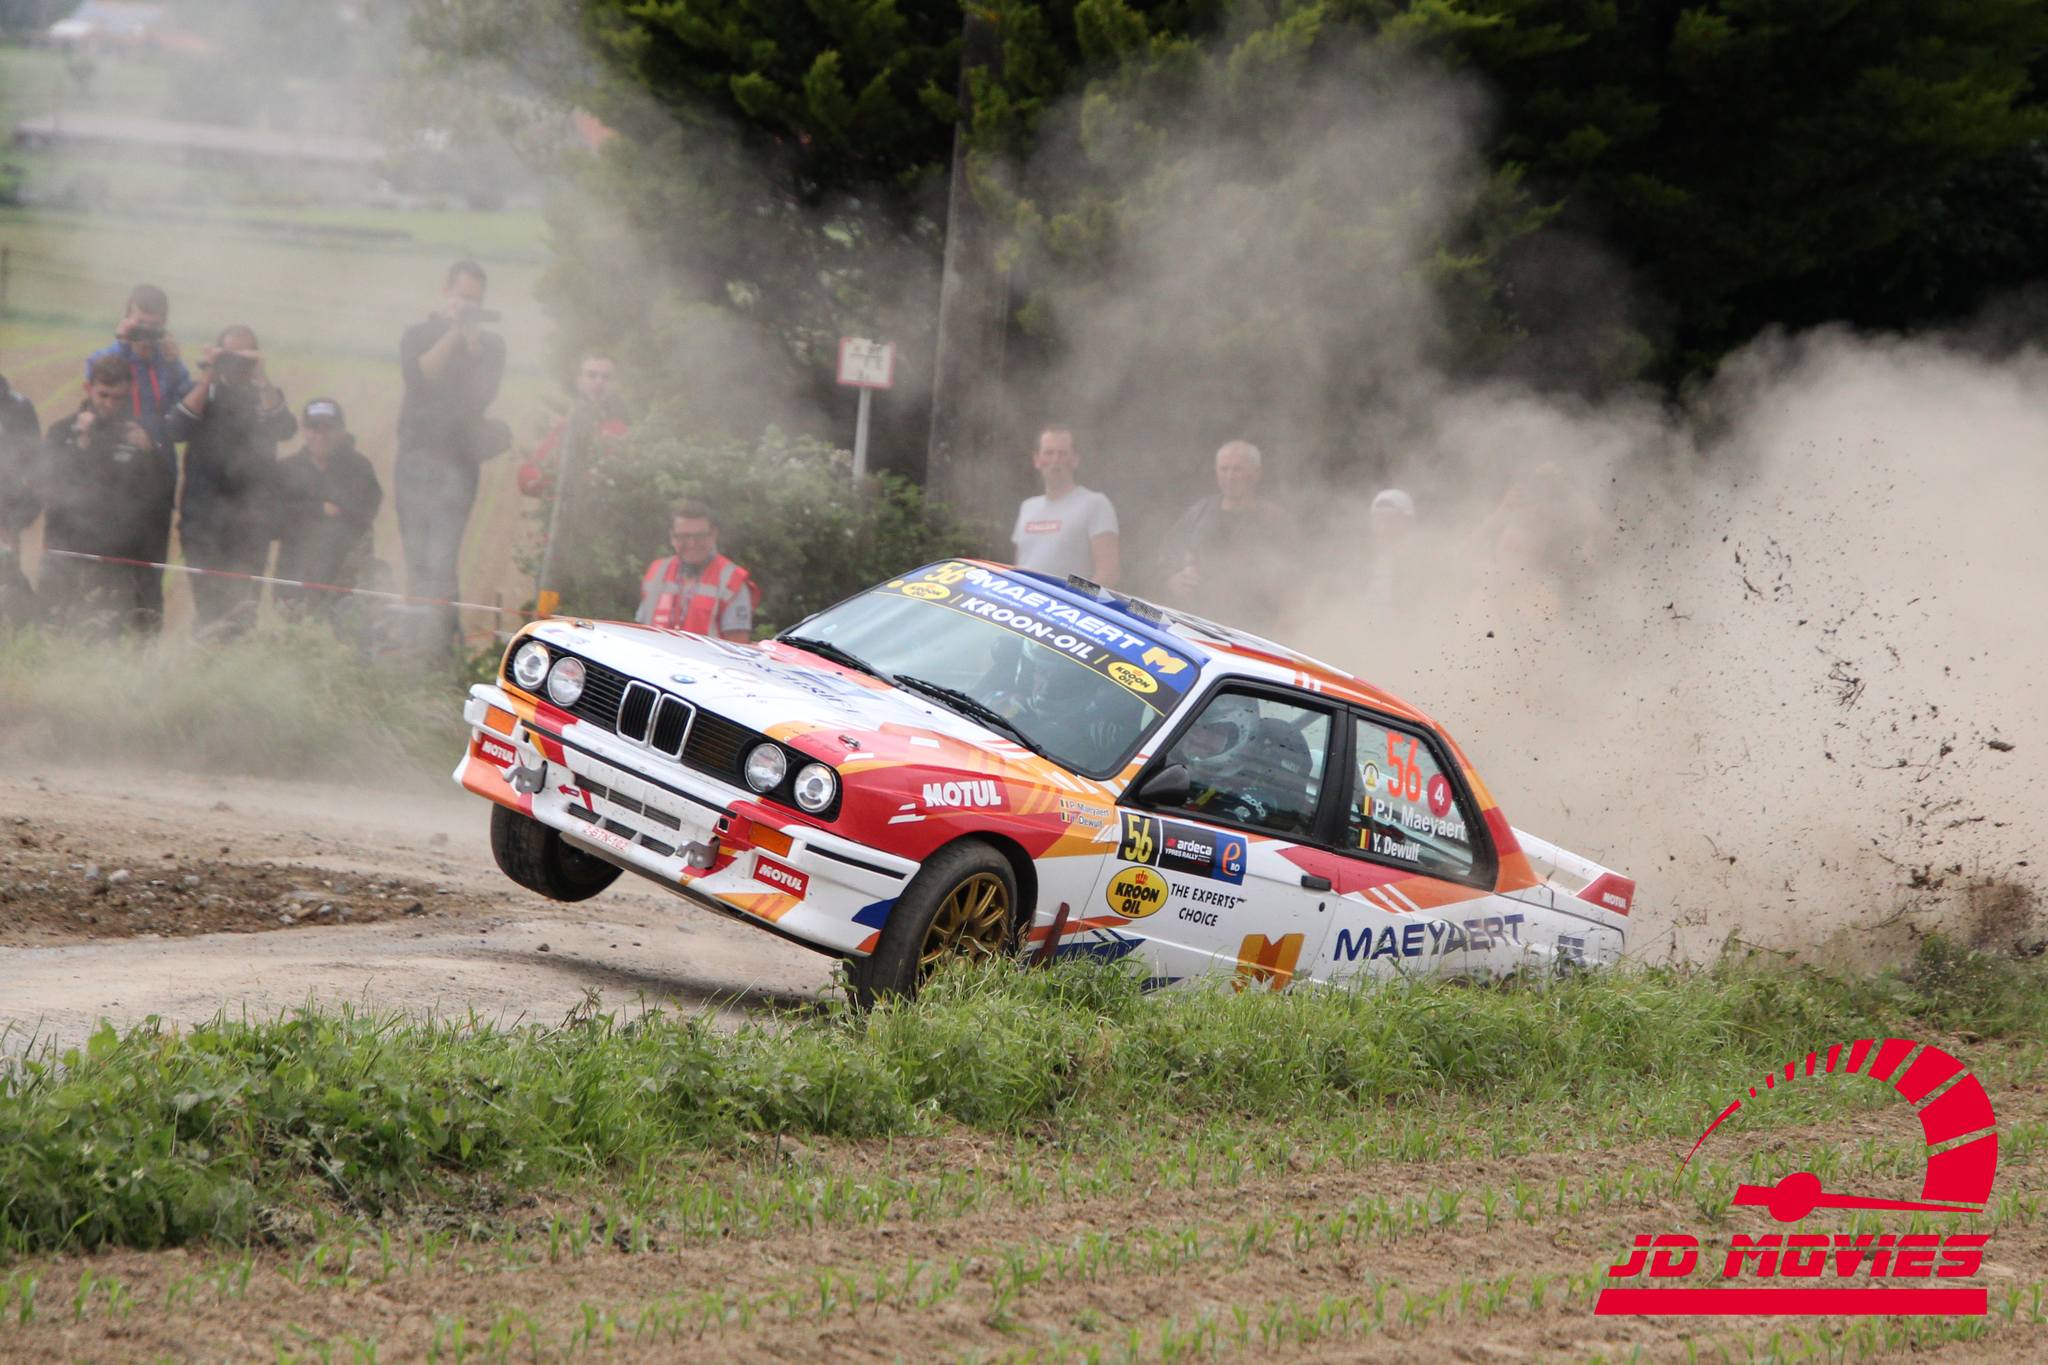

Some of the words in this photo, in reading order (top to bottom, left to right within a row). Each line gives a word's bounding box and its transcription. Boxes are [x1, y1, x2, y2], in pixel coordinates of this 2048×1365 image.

[965, 568, 1146, 649] MAEYAERT
[960, 597, 1094, 659] KROON-OIL
[1115, 666, 1150, 688] KROON
[1118, 675, 1134, 686] OIL
[482, 740, 514, 764] MOTUL
[1386, 730, 1422, 803] 56
[923, 779, 1002, 807] MOTUL
[1434, 783, 1445, 806] 4
[1401, 805, 1467, 840] Maeyaert
[1125, 813, 1153, 863] 56
[1177, 840, 1212, 856] ardeca
[1373, 832, 1381, 852] Y.
[1383, 836, 1420, 860] Dewulf
[1182, 850, 1199, 861] RALLY
[758, 863, 803, 891] MOTUL
[1115, 882, 1160, 903] KROON
[1171, 883, 1190, 899] THE
[1192, 888, 1236, 909] EXPERTS
[1602, 891, 1627, 910] MOTUL
[1121, 898, 1142, 914] OIL
[1178, 907, 1218, 927] CHOICE
[1333, 913, 1525, 961] MAEYAERT
